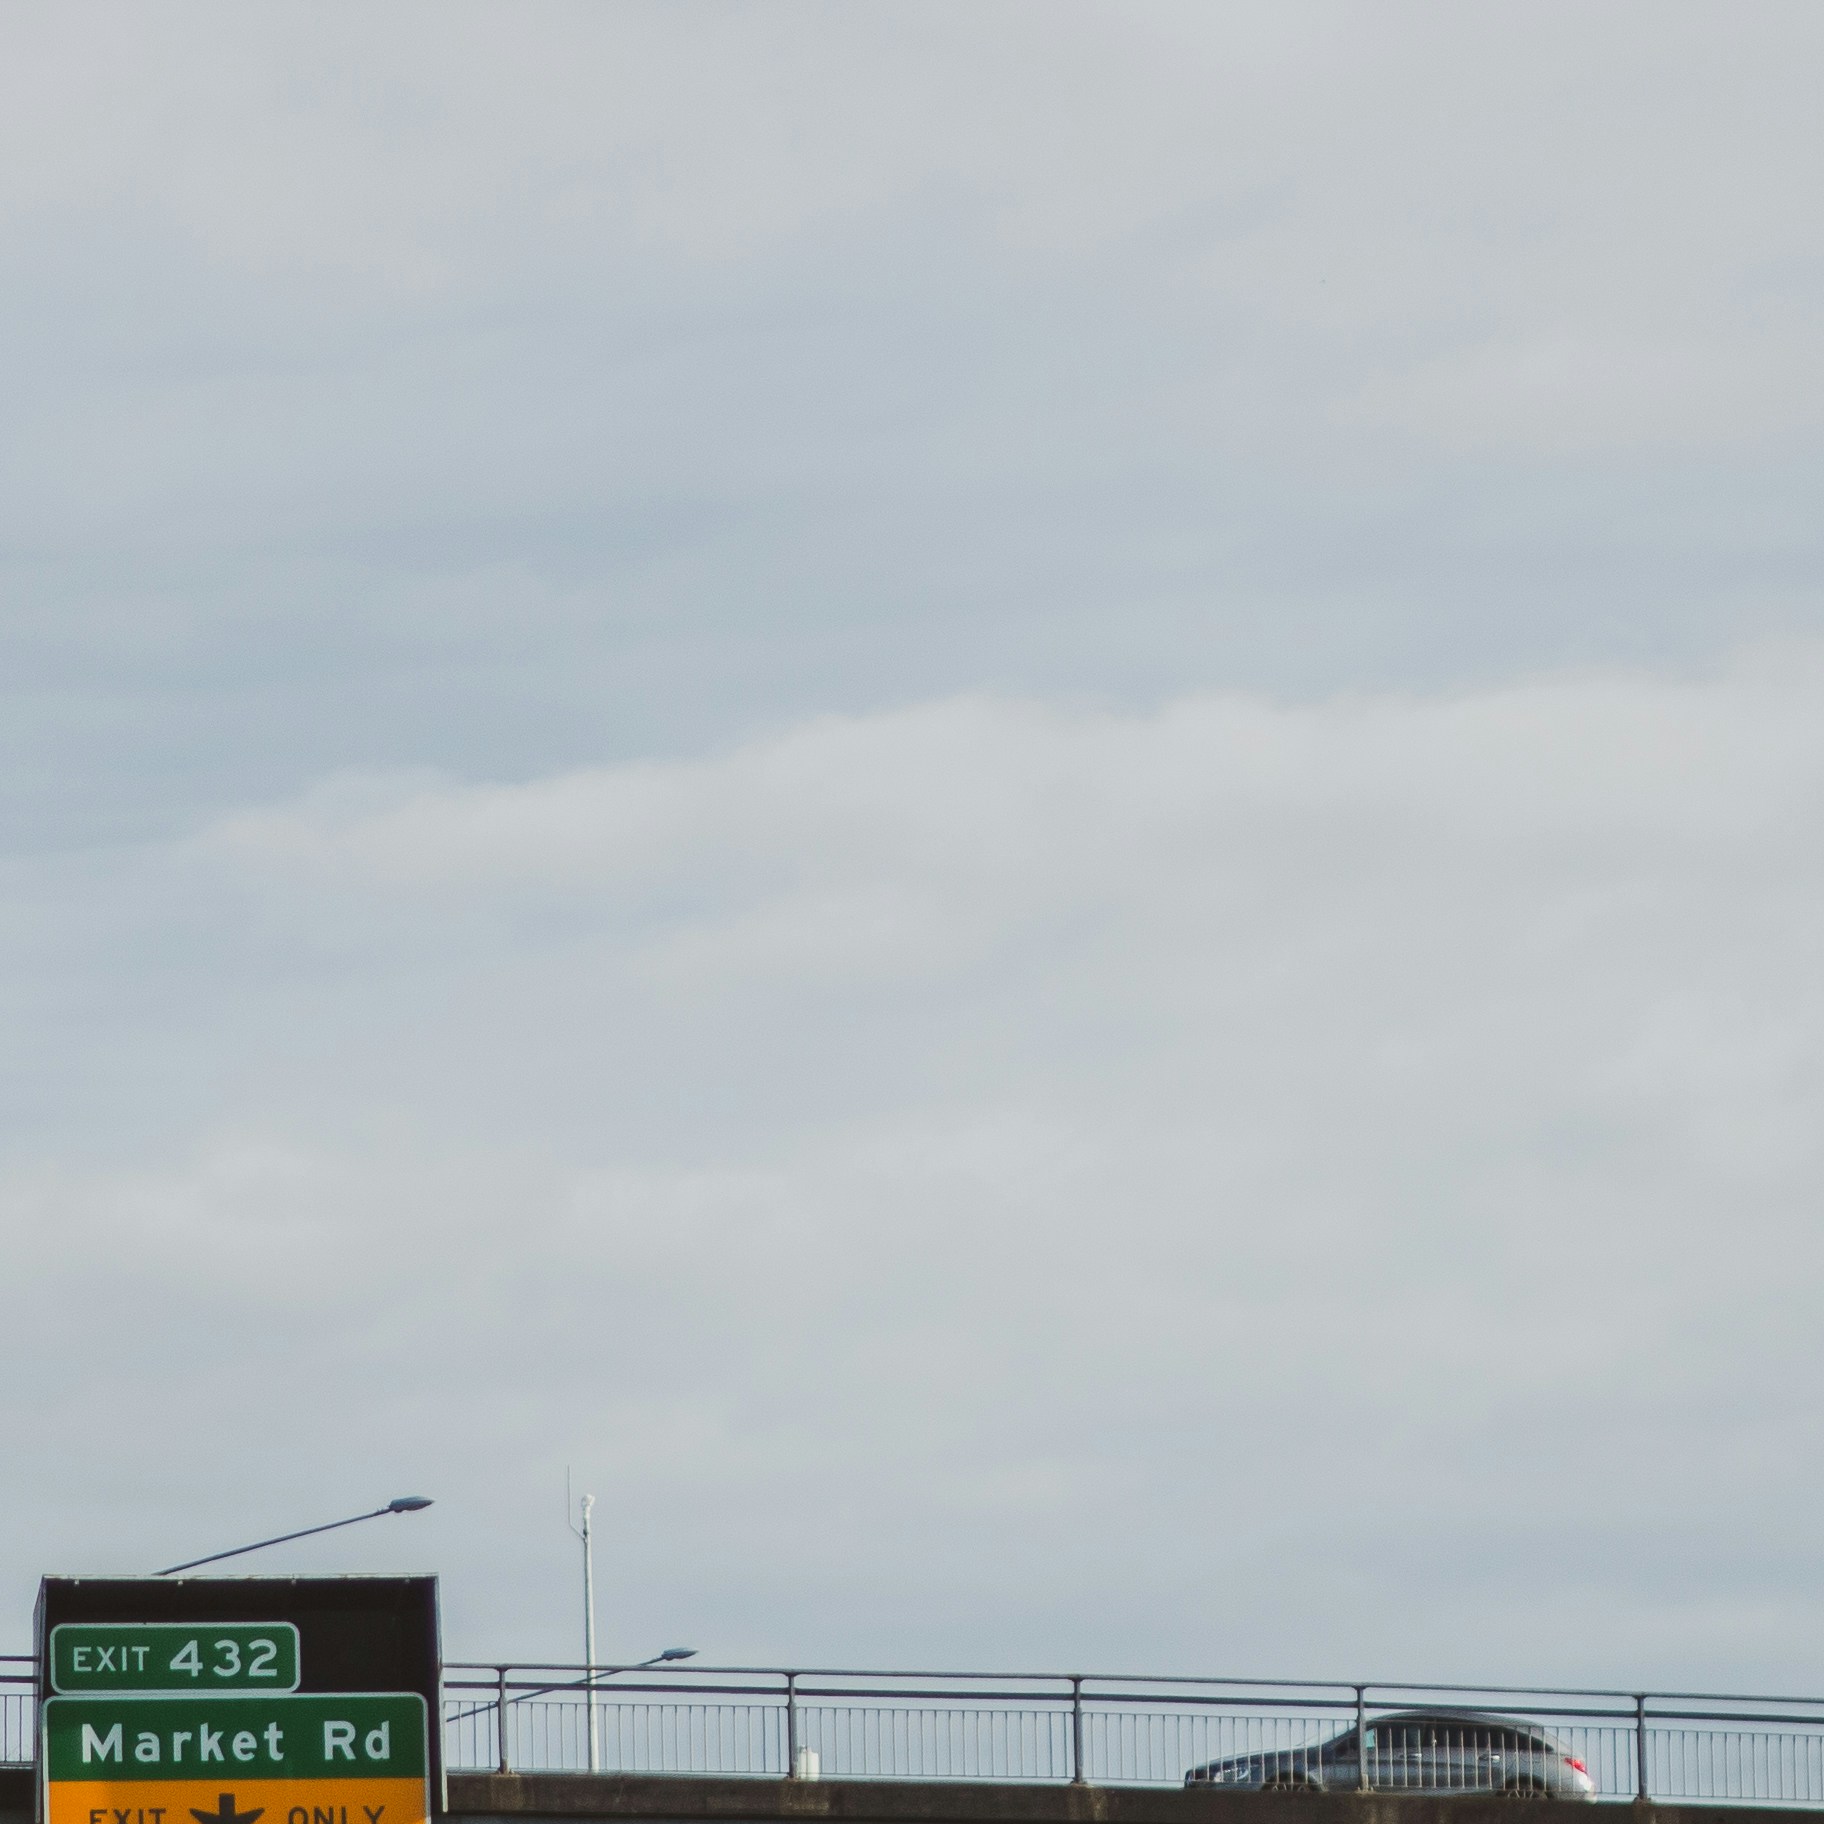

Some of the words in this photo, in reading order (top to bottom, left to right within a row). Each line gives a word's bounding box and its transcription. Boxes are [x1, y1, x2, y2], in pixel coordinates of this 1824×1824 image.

[73, 1646, 150, 1672] EXIT
[169, 1639, 278, 1677] 432
[81, 1721, 285, 1763] Market
[323, 1720, 391, 1761] Rd
